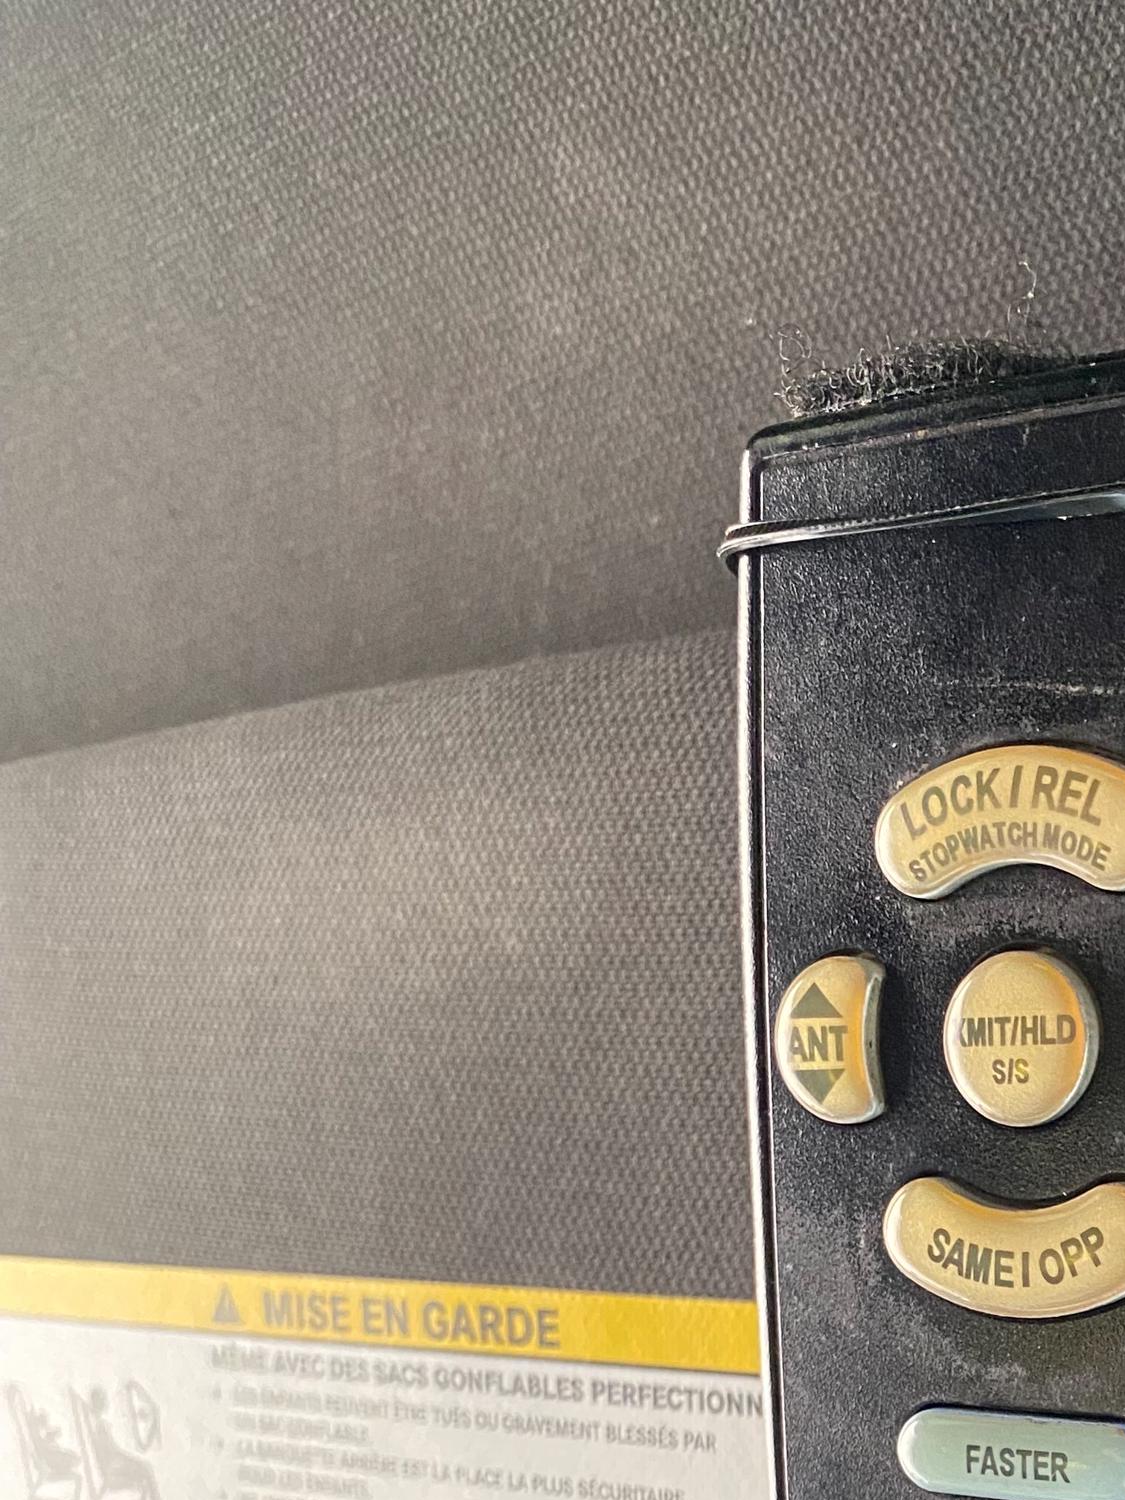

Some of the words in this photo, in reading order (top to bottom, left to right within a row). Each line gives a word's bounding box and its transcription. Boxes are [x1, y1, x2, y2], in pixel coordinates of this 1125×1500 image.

[900, 767, 1001, 841] LOCK
[1031, 765, 1101, 827] REL
[908, 821, 1038, 882] STOPWATCH
[1042, 822, 1112, 872] MODE
[790, 1024, 849, 1062] ANT
[991, 1057, 1030, 1085] S/S
[927, 1227, 1015, 1289] SAME
[1038, 1226, 1104, 1285] OPP
[262, 1289, 351, 1333] MISE
[361, 1297, 410, 1337] EN
[421, 1300, 561, 1349] GARDE
[273, 1350, 325, 1379] AVEC
[330, 1357, 369, 1383] DES
[373, 1362, 428, 1388] SACS
[433, 1367, 585, 1403] GONFLABLES
[501, 1412, 601, 1443] GRAVEMENT
[605, 1424, 679, 1451] BLESSÉS
[684, 1431, 718, 1453] PAR
[531, 1475, 574, 1498] PLUS
[965, 1445, 1070, 1484] FASTER
